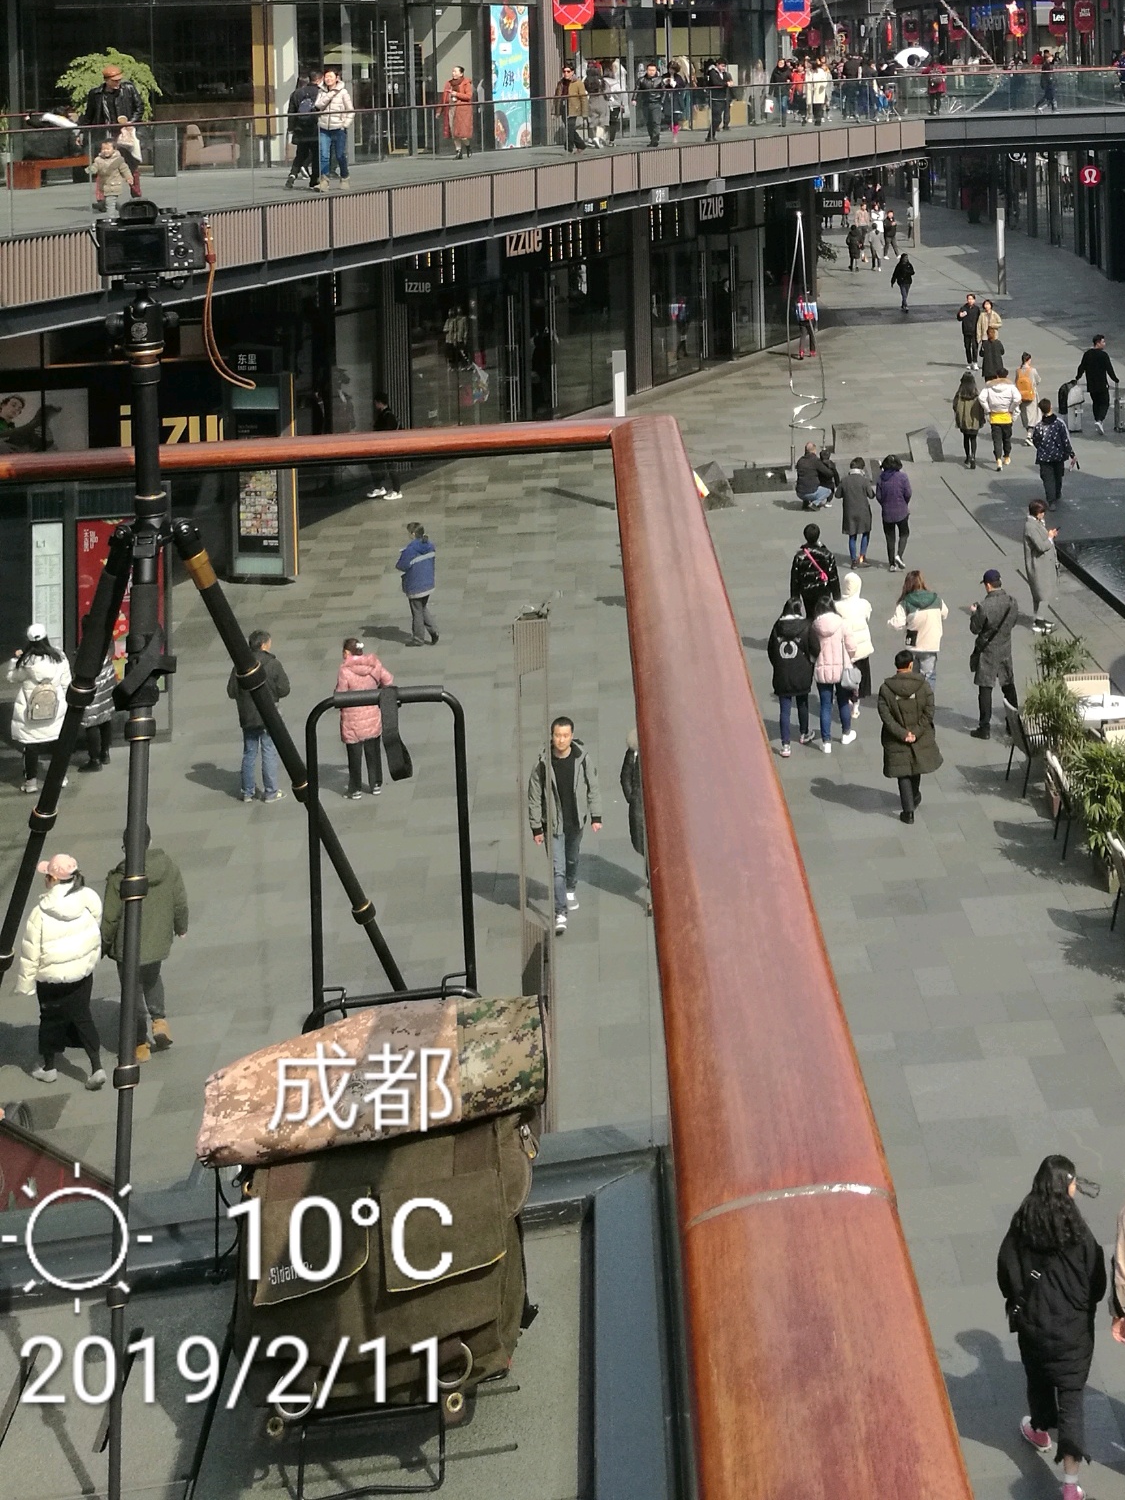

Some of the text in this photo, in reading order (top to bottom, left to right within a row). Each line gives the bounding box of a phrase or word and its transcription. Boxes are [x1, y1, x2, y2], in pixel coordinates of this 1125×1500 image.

[1053, 13, 1065, 22] Lee
[699, 195, 724, 221] izzue
[823, 198, 842, 208] izzue
[505, 228, 543, 258] izzue
[404, 278, 432, 293] izzue
[237, 353, 257, 365] 东里
[119, 404, 224, 448] izu
